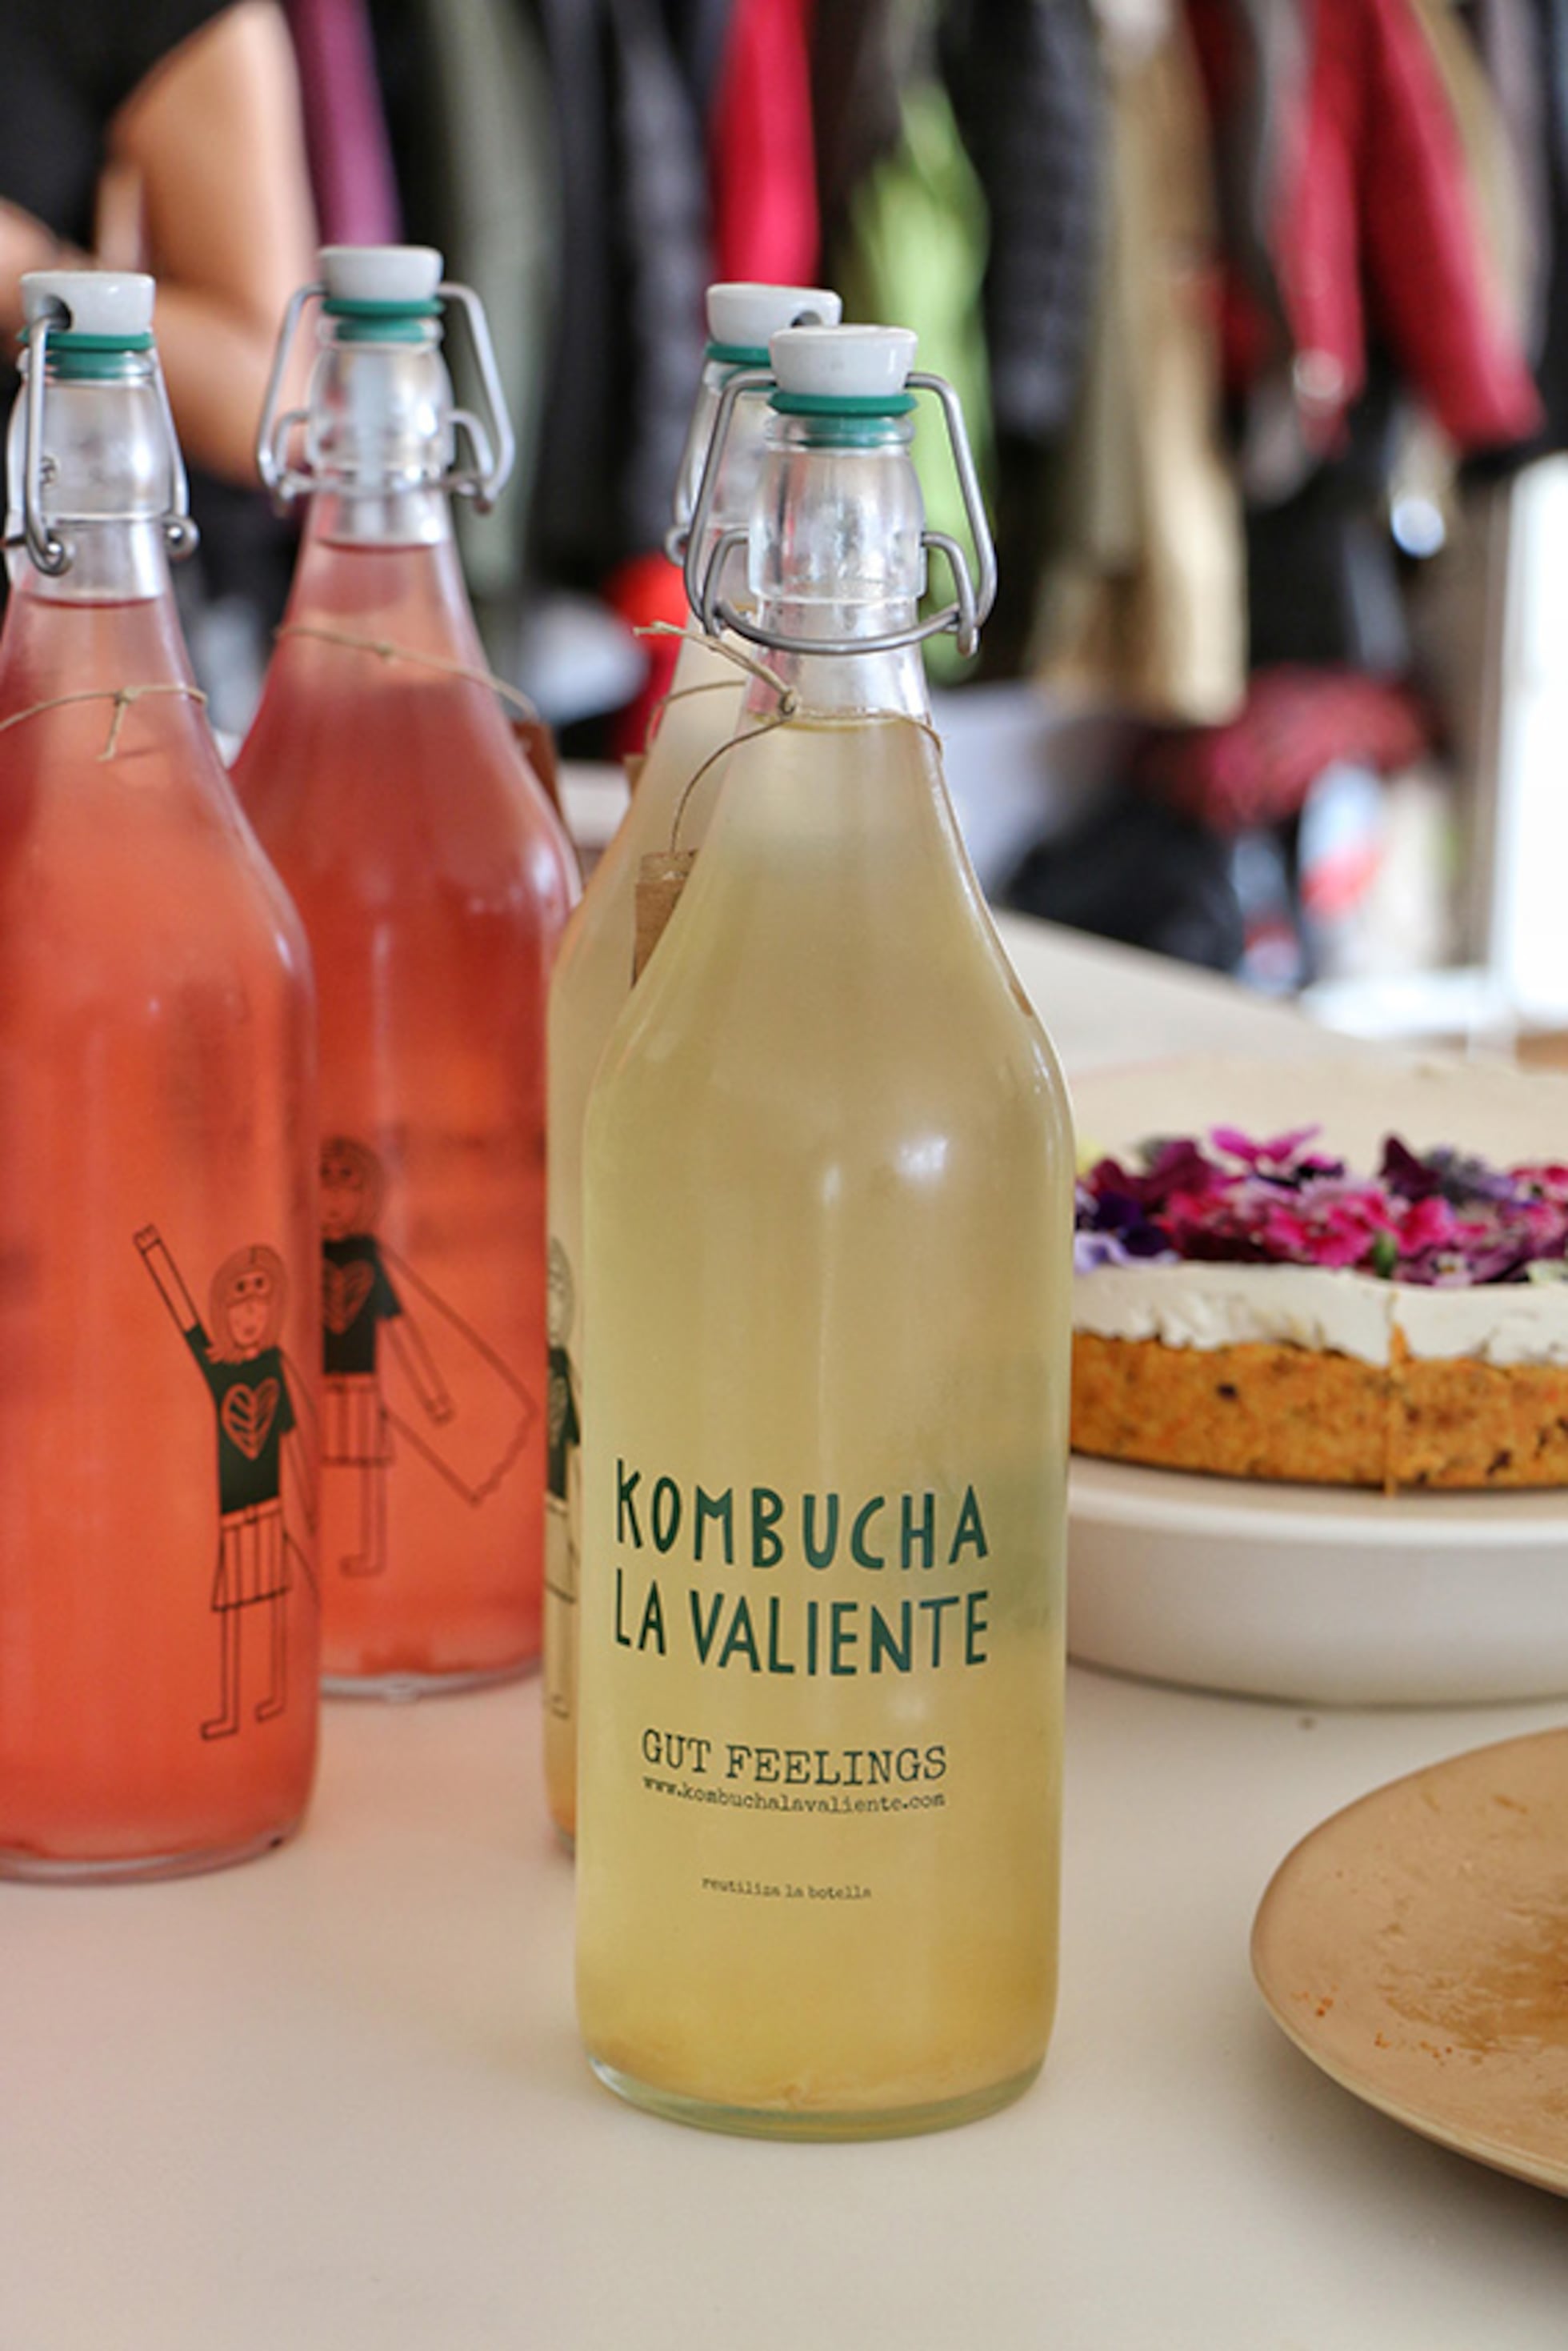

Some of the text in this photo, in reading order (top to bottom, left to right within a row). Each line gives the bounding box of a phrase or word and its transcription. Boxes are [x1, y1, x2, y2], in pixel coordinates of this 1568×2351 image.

[618, 1458, 988, 1570] KOMBUCHA
[615, 1568, 988, 1676] LA VALIENTE
[642, 1728, 946, 1786] GUT FEELINGS
[642, 1775, 946, 1814] www.kombuchalavaliente.com
[702, 1876, 872, 1900] reutiliza la botella
